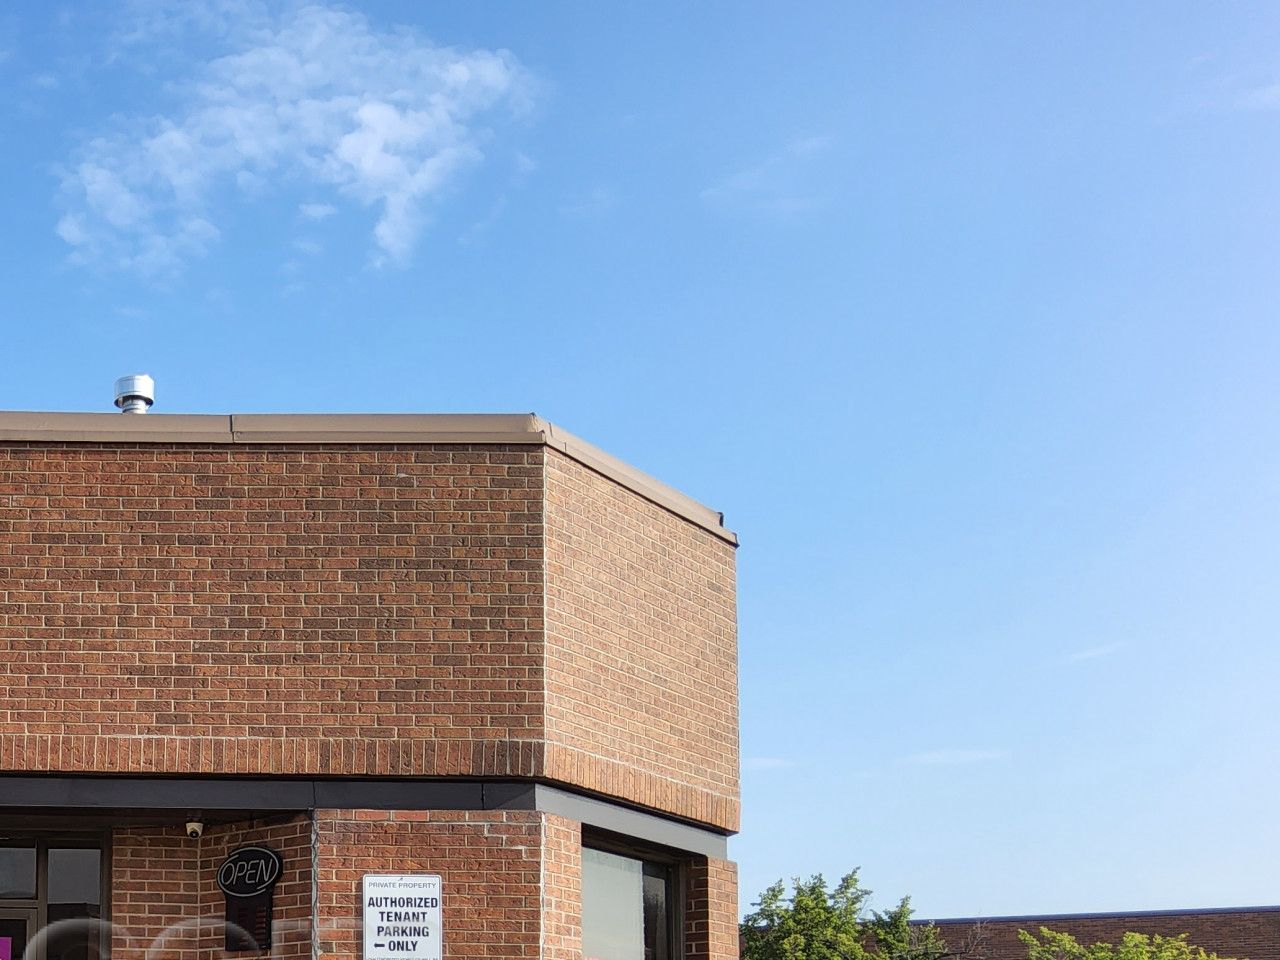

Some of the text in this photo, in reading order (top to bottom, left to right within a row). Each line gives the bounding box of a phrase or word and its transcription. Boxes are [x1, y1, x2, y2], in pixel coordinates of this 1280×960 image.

[221, 859, 273, 885] OPEN
[367, 896, 438, 908] AUTHORIZED
[378, 911, 428, 922] TENANT
[377, 925, 429, 937] PARKING
[388, 940, 418, 952] ONLY
